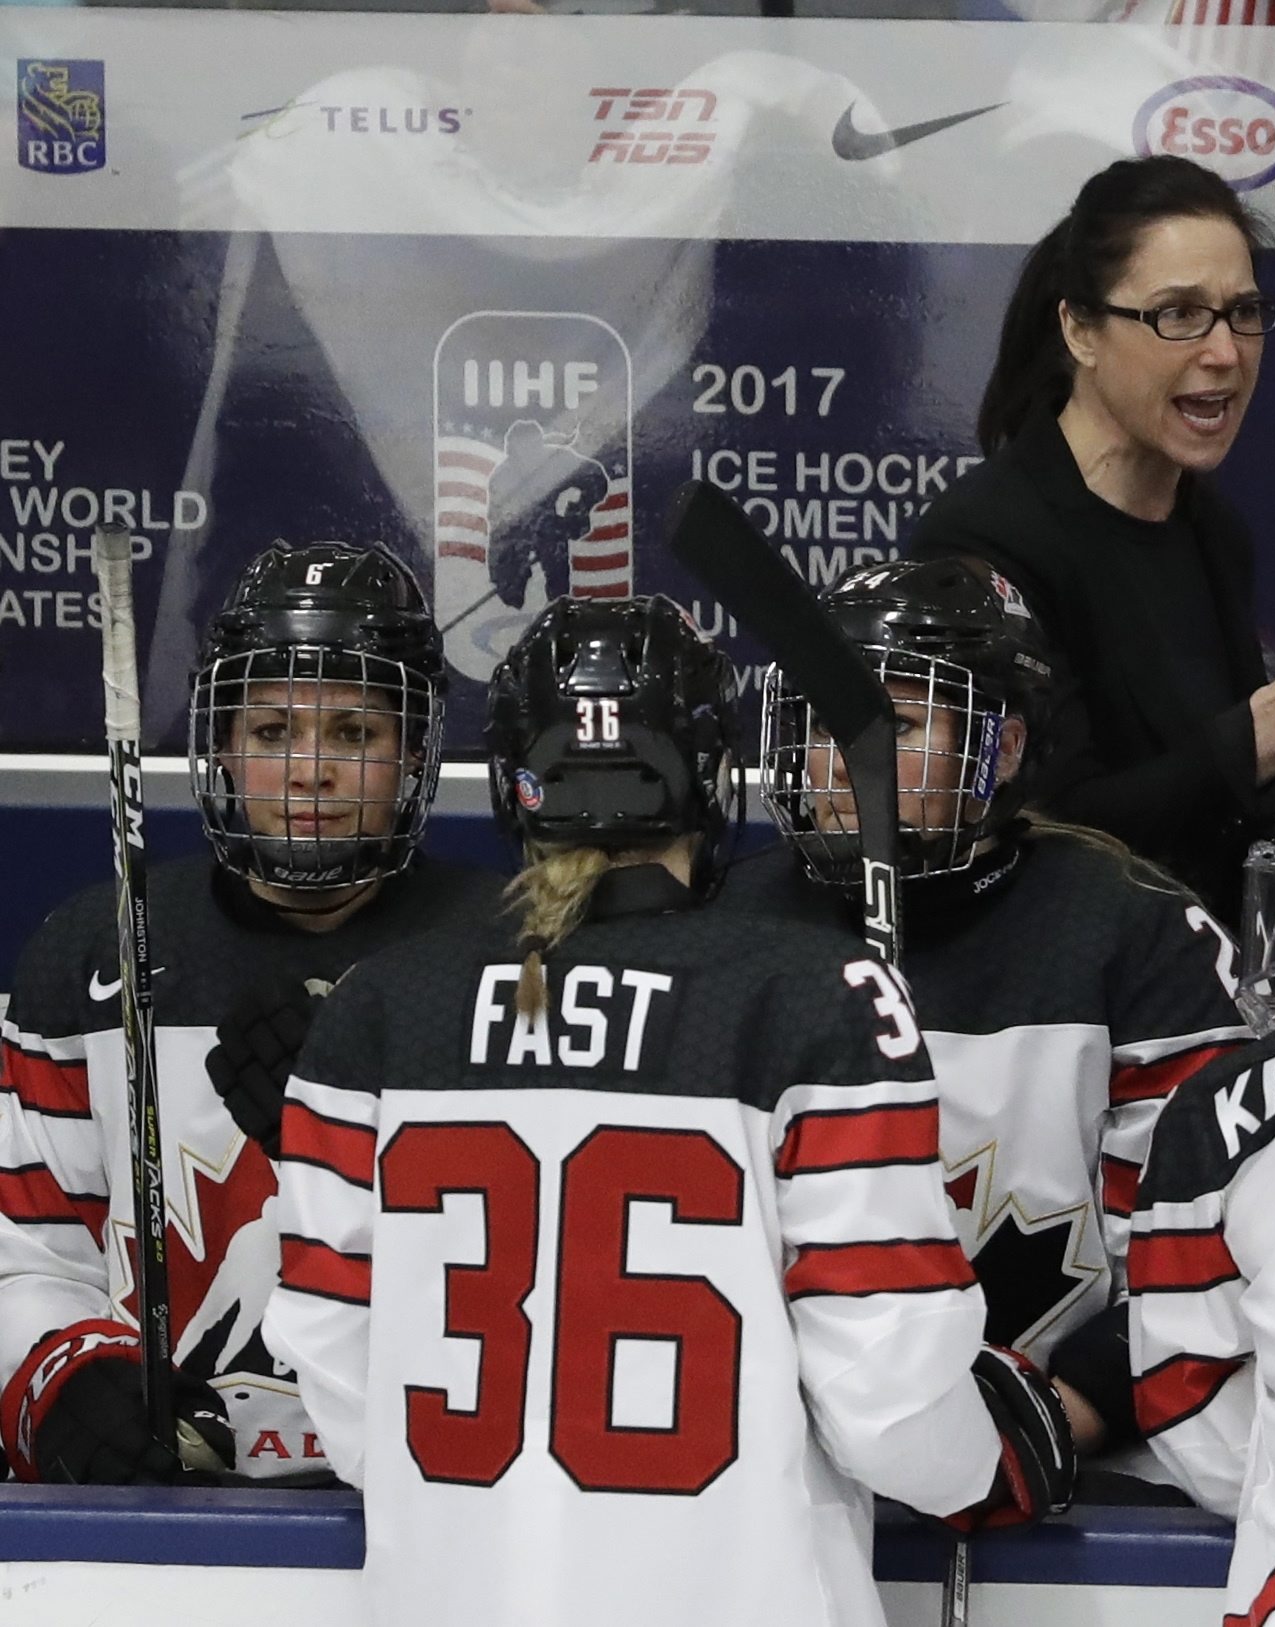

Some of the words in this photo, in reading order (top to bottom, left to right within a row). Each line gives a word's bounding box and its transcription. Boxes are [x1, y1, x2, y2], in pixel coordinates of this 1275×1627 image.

[320, 105, 461, 133] TELUS
[589, 88, 717, 121] TSN
[28, 141, 98, 165] RBC
[588, 131, 717, 164] RDS
[463, 360, 599, 409] IIHF
[692, 366, 845, 416] 2017
[692, 449, 778, 491] ICE
[796, 452, 985, 495] HOCK
[10, 485, 207, 530] WORLD
[734, 496, 932, 541] OMEN'
[0, 532, 152, 574] NSHP
[306, 564, 323, 585] 6
[576, 698, 619, 740] 36
[135, 897, 148, 963] JOHNSTON
[470, 964, 672, 1070] FAST
[146, 1106, 158, 1158] SUPER
[145, 1158, 163, 1240] TACKS
[378, 1120, 745, 1497] 36
